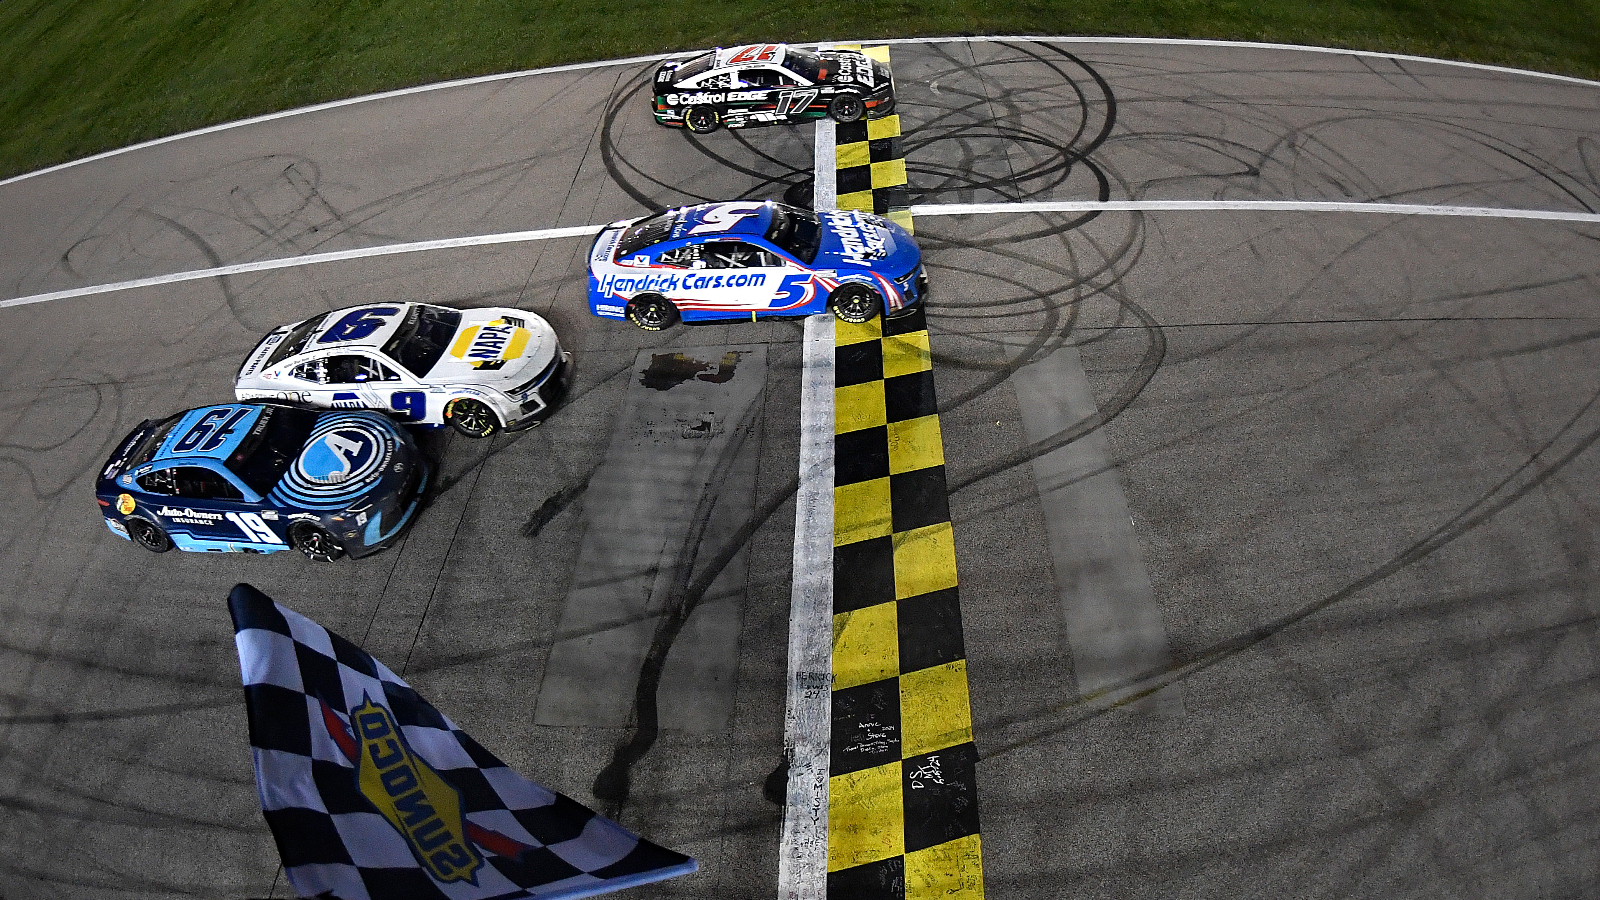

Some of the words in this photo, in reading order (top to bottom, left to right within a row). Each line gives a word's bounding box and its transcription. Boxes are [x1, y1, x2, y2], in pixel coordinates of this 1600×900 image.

[680, 92, 726, 105] Castrol
[727, 90, 769, 101] EDGE
[775, 89, 818, 115] 17
[768, 273, 813, 308] 5
[468, 325, 514, 359] NAPA
[390, 390, 426, 423] 9
[252, 412, 270, 436] TRUEX
[157, 506, 224, 521] Auto-Owners
[172, 517, 214, 526] INSURANCE
[225, 511, 284, 545] 19
